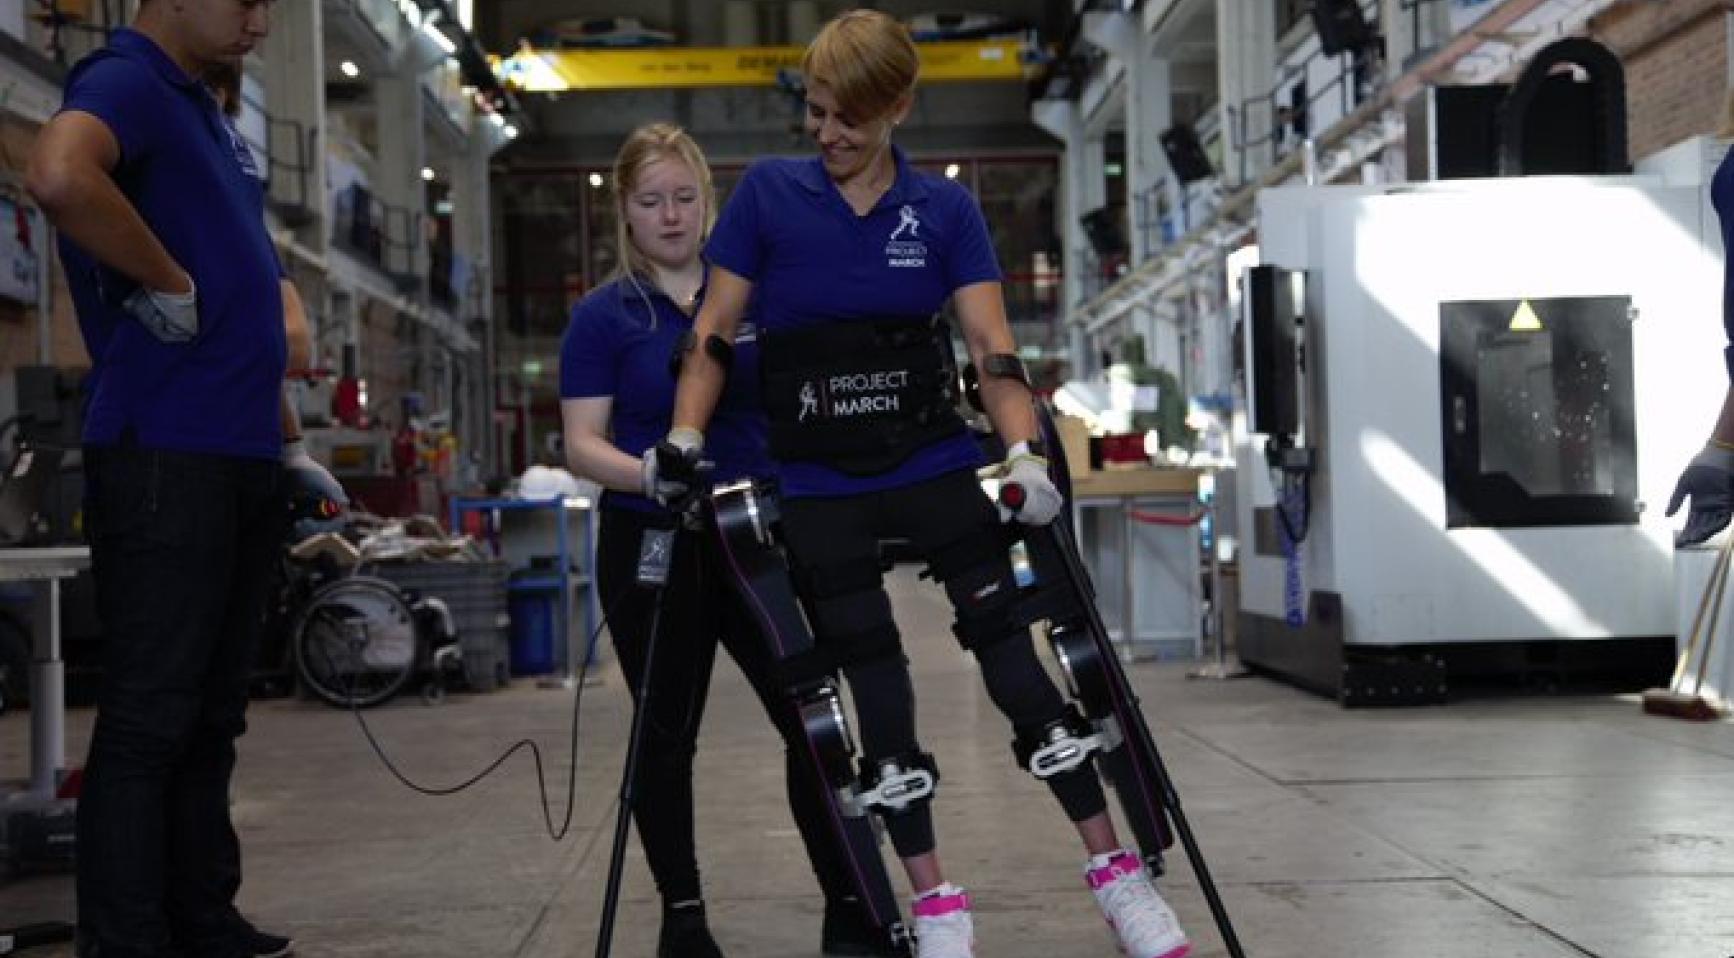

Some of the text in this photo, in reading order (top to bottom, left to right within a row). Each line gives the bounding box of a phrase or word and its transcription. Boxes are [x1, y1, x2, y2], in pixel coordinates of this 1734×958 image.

[888, 258, 925, 268] MARCH
[830, 370, 909, 392] PROJECT
[834, 394, 900, 417] MARCH
